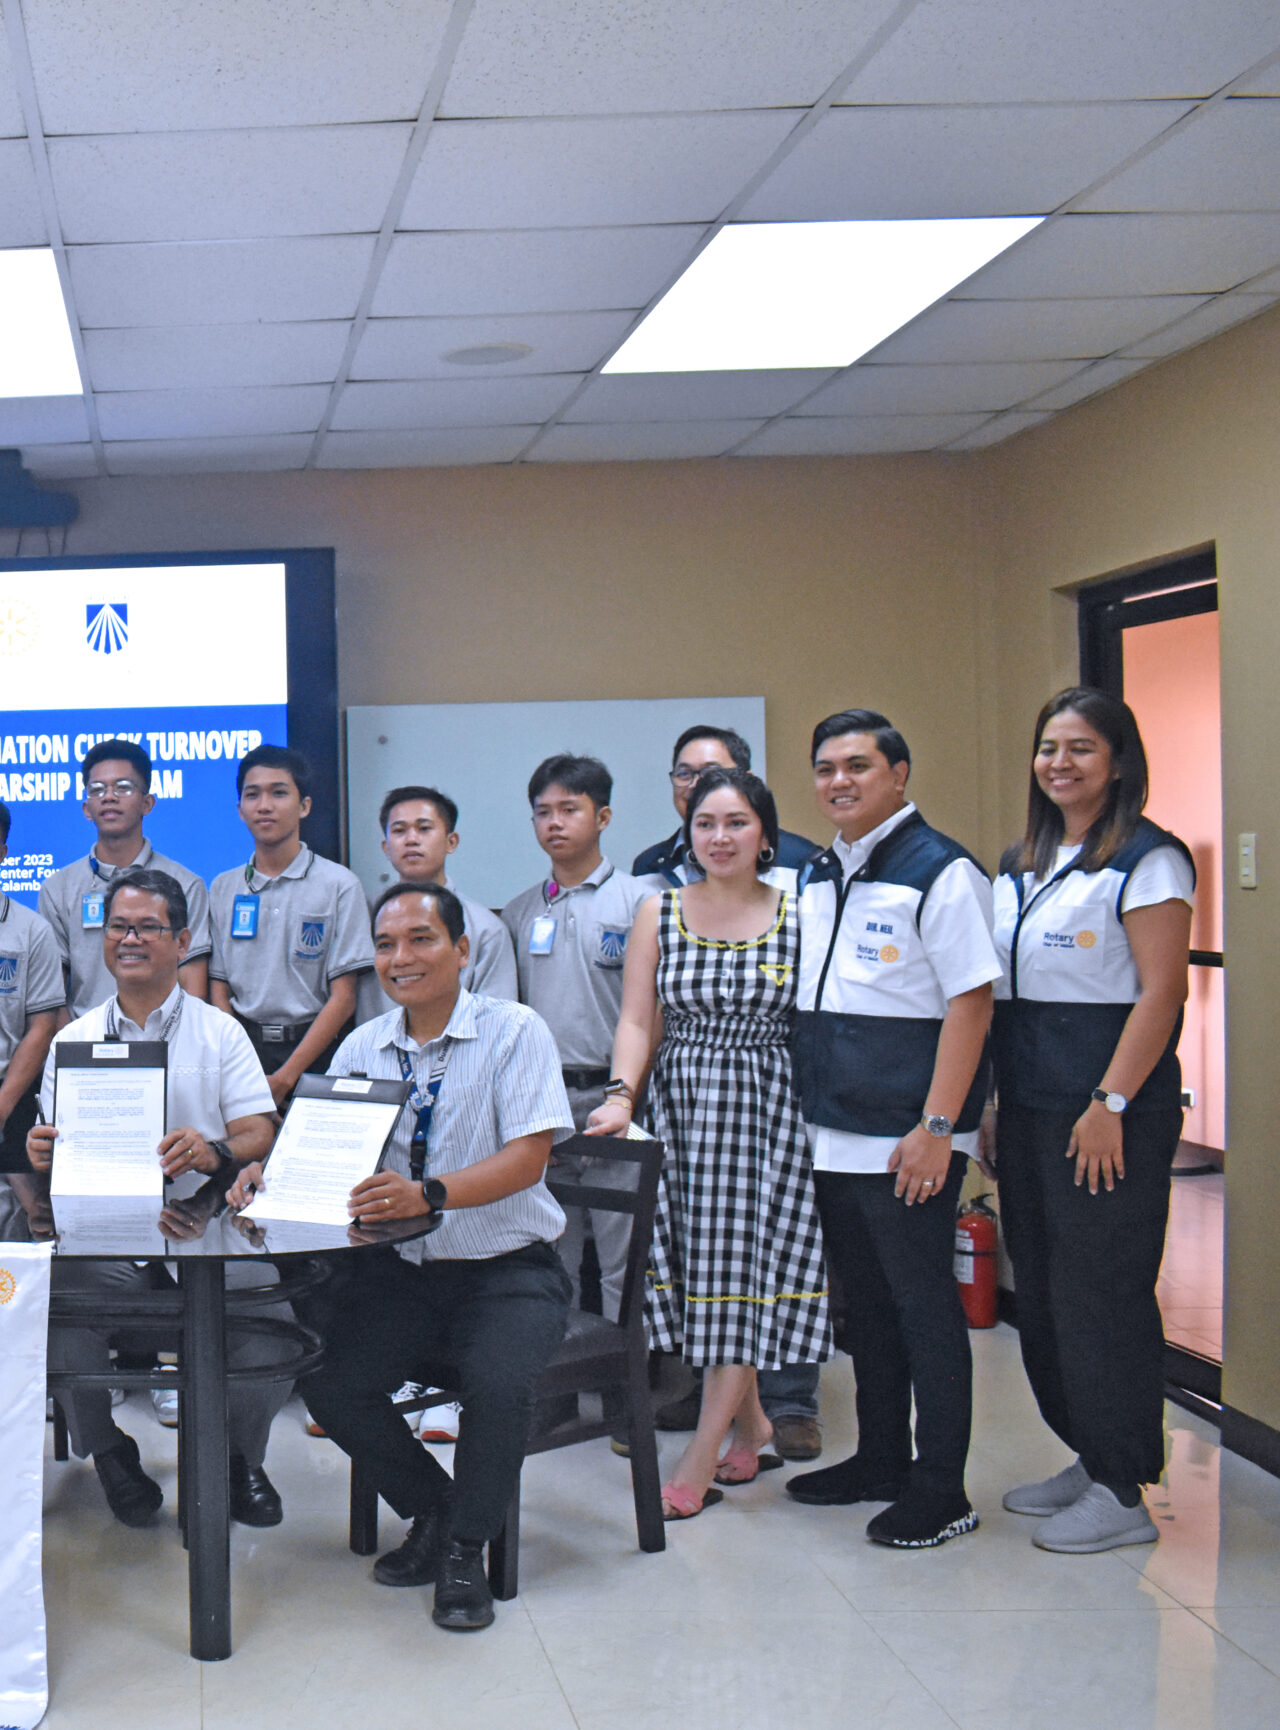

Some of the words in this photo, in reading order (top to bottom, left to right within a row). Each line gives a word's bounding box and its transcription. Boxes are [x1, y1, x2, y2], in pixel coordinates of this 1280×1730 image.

[146, 729, 263, 762] TURNOVER
[23, 853, 54, 866] 2023
[1043, 932, 1074, 944] Rotary
